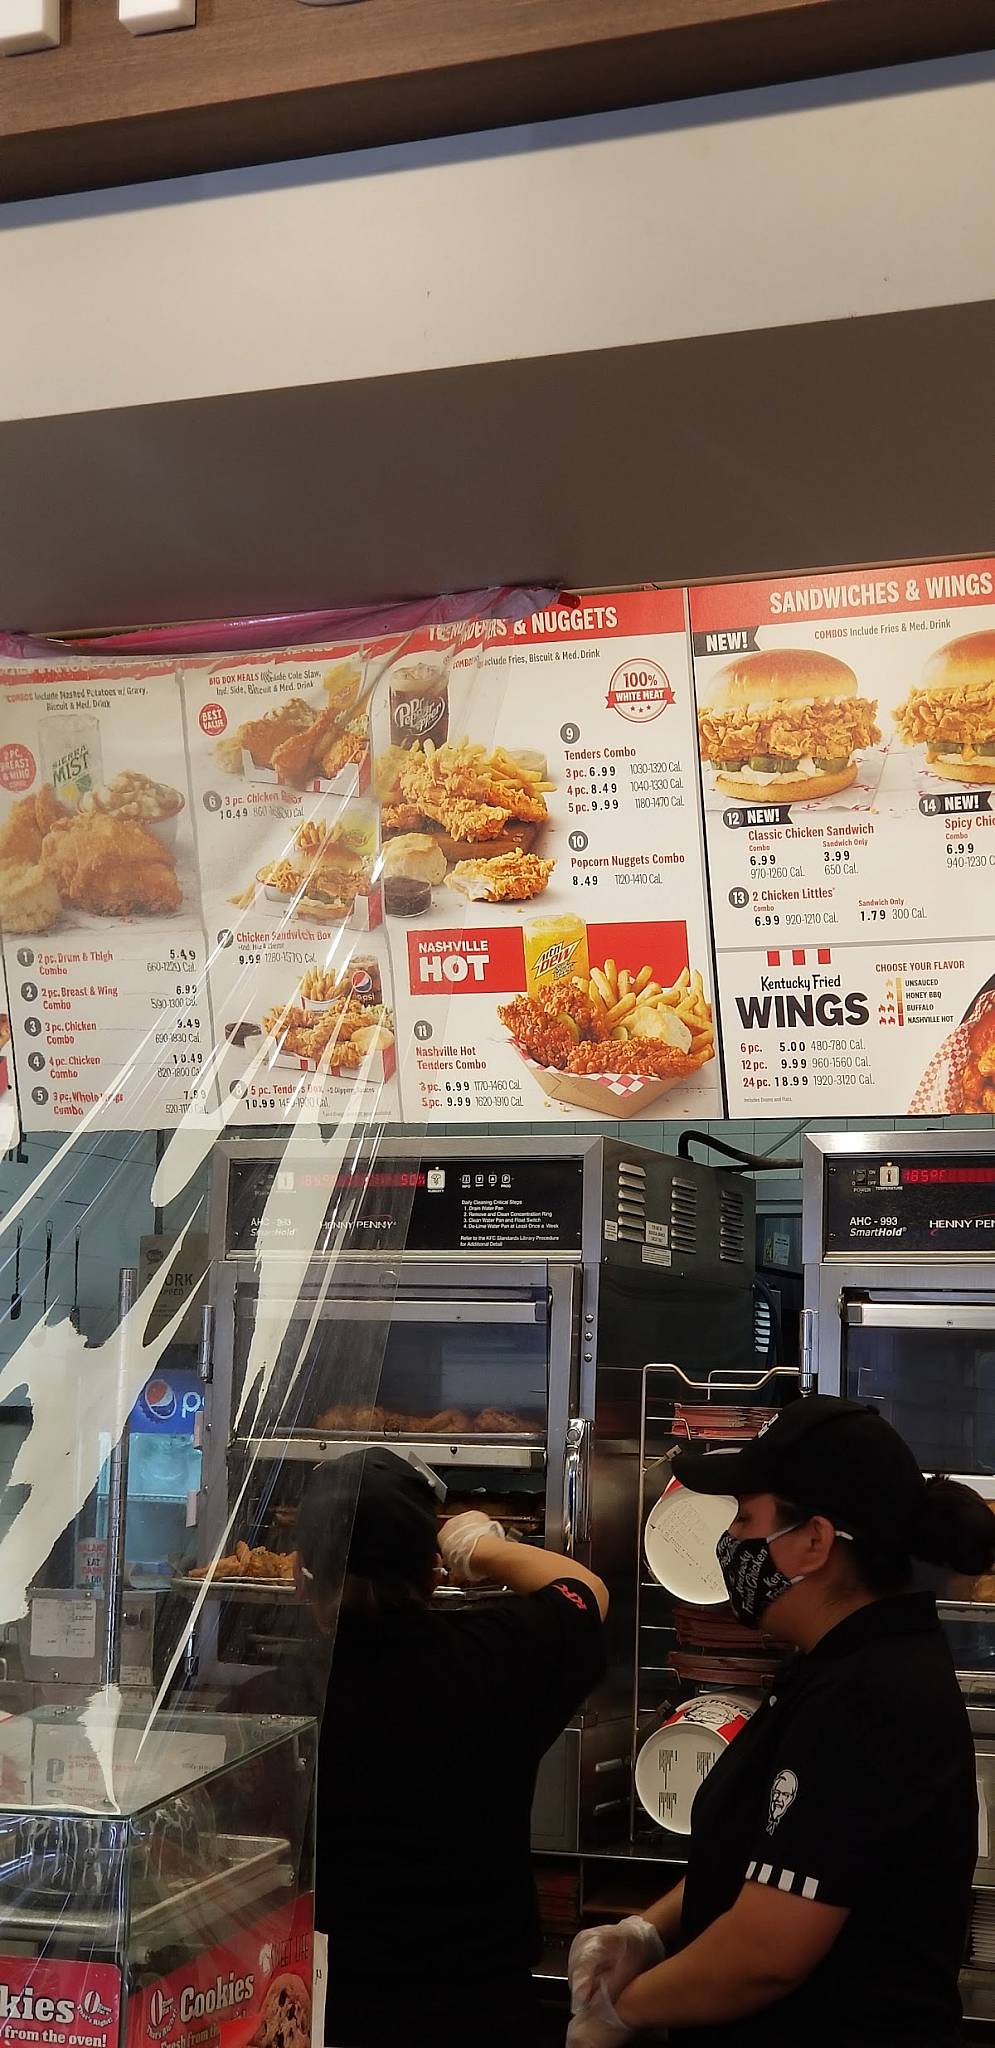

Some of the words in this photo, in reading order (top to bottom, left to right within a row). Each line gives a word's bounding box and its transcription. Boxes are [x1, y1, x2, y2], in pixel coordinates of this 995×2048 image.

[770, 581, 899, 614] SANDWICHES
[906, 580, 919, 601] &
[925, 572, 993, 599] WINGS
[514, 620, 526, 635] &
[532, 607, 617, 633] NUGGETS
[814, 628, 848, 639] COMBOS
[850, 624, 878, 636] Include
[881, 623, 899, 634] Fries
[909, 621, 928, 631] Med.
[930, 619, 951, 630] Drink
[706, 631, 747, 652] NEW!
[509, 654, 527, 664] Fries,
[529, 652, 553, 662] Biscuit
[562, 651, 579, 659] Med.
[581, 649, 600, 658] Drink
[623, 672, 657, 688] 100%
[616, 690, 641, 701] WHITE
[202, 709, 222, 720] BEST
[203, 720, 224, 729] VALUE
[564, 749, 601, 760] Tenders
[604, 746, 636, 758] Combo
[53, 751, 89, 787] MIST
[566, 769, 571, 778] 3
[573, 769, 587, 780] pc.
[589, 766, 616, 776] 6.99
[630, 762, 667, 774] 1030-1320
[669, 761, 682, 772] Cal.
[567, 785, 573, 795] 4
[575, 786, 588, 797] pc.
[591, 783, 617, 794] 8.49
[631, 779, 668, 791] 1040-1330
[670, 778, 684, 789] Cal.
[247, 792, 278, 803] Chicken
[568, 802, 573, 813] 5
[576, 804, 589, 814] pc.
[592, 799, 619, 811] 9.99
[635, 797, 669, 808] 1180-1470
[671, 796, 684, 806] Cal.
[726, 812, 740, 825] 12
[747, 808, 780, 824] NEW!
[922, 799, 937, 812] 14
[944, 794, 979, 811] NEW!
[220, 808, 248, 820] 10.49
[945, 817, 972, 830] Spicy
[748, 829, 782, 841] Classic
[785, 826, 824, 839] Chicken
[827, 823, 874, 837] Sandwich
[572, 836, 584, 848] 10
[854, 839, 868, 847] Only
[947, 843, 974, 854] 6.99
[571, 856, 609, 869] Popcorn
[612, 854, 650, 867] Nuggets
[652, 853, 685, 865] Combo
[750, 855, 776, 866] 6.99
[824, 850, 850, 861] 3.99
[947, 855, 986, 868] 940-1230
[750, 867, 788, 880] 970-1260
[790, 866, 805, 877] Cal.
[824, 865, 841, 875] 650
[843, 863, 858, 874] Cal.
[572, 875, 598, 886] 8.49
[615, 874, 647, 885] 1120-1410
[649, 873, 662, 884] Cal.
[732, 892, 745, 904] 13
[761, 889, 799, 901] Chicken
[753, 904, 774, 912] Combo
[890, 898, 904, 906] Only
[755, 916, 780, 927] 6.99
[785, 913, 821, 925] 920-1210
[823, 912, 838, 924] Cal.
[860, 910, 886, 921] 1.79
[892, 908, 909, 920] 300
[911, 907, 927, 919] Cal.
[236, 931, 269, 942] Chicken
[418, 940, 488, 953] NASHVILLE
[58, 953, 80, 963] Drum
[90, 951, 113, 961] Thigh
[170, 950, 196, 959] 5.49
[239, 954, 261, 965] 9.99
[40, 967, 67, 975] Combo
[419, 954, 490, 982] HOT
[875, 963, 908, 973] CHOOSE
[909, 962, 932, 971] YOUR
[934, 961, 965, 970] FLAVOR
[761, 975, 810, 991] Kentucky
[812, 974, 841, 988] Fried
[905, 979, 938, 987] UNSAUCED
[61, 987, 88, 997] Breast
[97, 986, 118, 997] Wing
[906, 991, 927, 999] HONEY
[929, 991, 941, 999] BBQ
[43, 1001, 71, 1010] Combo
[735, 992, 870, 1029] WINGS
[177, 1019, 200, 1028] 9.49
[907, 1016, 939, 1024] NASHVILLE
[941, 1015, 953, 1023] HOT
[52, 1023, 63, 1032] pc.
[65, 1021, 96, 1031] Chicken
[47, 1035, 75, 1044] Combo
[416, 1045, 457, 1056] Nashville
[461, 1046, 476, 1056] Hot
[740, 1043, 746, 1053] 6
[748, 1044, 762, 1055] pc.
[779, 1041, 805, 1052] 5.00
[810, 1040, 847, 1051] 480-780
[849, 1039, 865, 1050] Cal.
[68, 1056, 100, 1066] Chicken
[417, 1060, 453, 1069] Tenders
[456, 1059, 486, 1069] Combo
[742, 1060, 751, 1070] 12
[753, 1061, 767, 1072] pc.
[781, 1058, 807, 1069] 9.99
[812, 1057, 852, 1068] 960-1560
[855, 1056, 871, 1067] Cal.
[50, 1070, 78, 1079] Combo
[427, 1084, 441, 1093] pc.
[445, 1082, 469, 1091] 6.99
[509, 1080, 521, 1090] Cal.
[743, 1077, 755, 1087] 24
[757, 1078, 771, 1089] pc.
[775, 1076, 808, 1087] 18.99
[813, 1074, 857, 1086] 1920-3120
[859, 1074, 875, 1085] Cal.
[246, 1099, 275, 1110] 10.99
[429, 1098, 442, 1108] pc.
[447, 1097, 471, 1107] 9.99
[510, 1096, 523, 1106] Cal.
[54, 1105, 84, 1115] Combo
[357, 1221, 393, 1229] PENNY
[850, 1217, 871, 1226] AHC
[880, 1217, 897, 1225] 993
[930, 1220, 972, 1228] HENNY
[180, 1969, 255, 2023] Cookies
[5, 2025, 39, 2041] from
[42, 2029, 65, 2043] the
[69, 2034, 107, 2047] oven!
